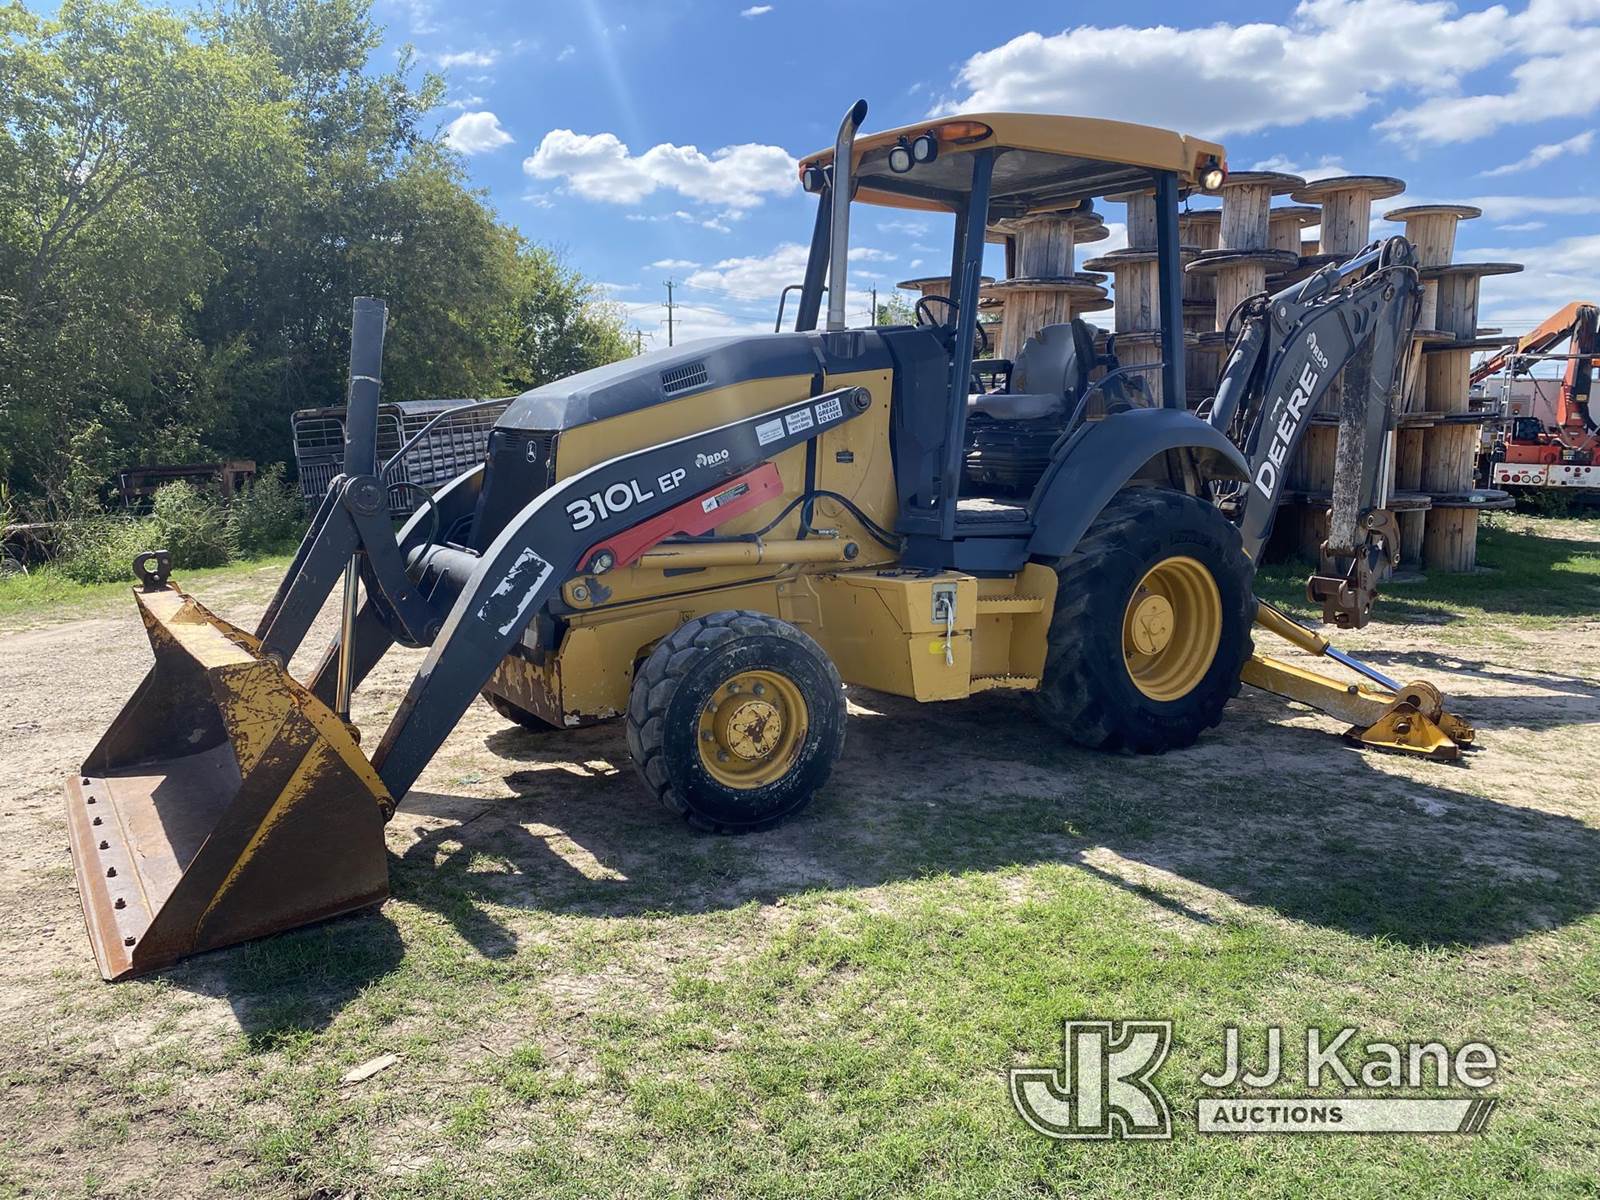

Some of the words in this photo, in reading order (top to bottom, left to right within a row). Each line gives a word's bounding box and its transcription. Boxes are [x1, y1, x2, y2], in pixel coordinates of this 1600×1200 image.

[1313, 345, 1329, 369] RDO
[818, 405, 840, 417] GREASE
[821, 400, 837, 409] NEED
[1255, 362, 1318, 500] DEERE
[707, 449, 729, 465] RDO
[566, 480, 655, 531] 310L
[657, 468, 686, 493] EP
